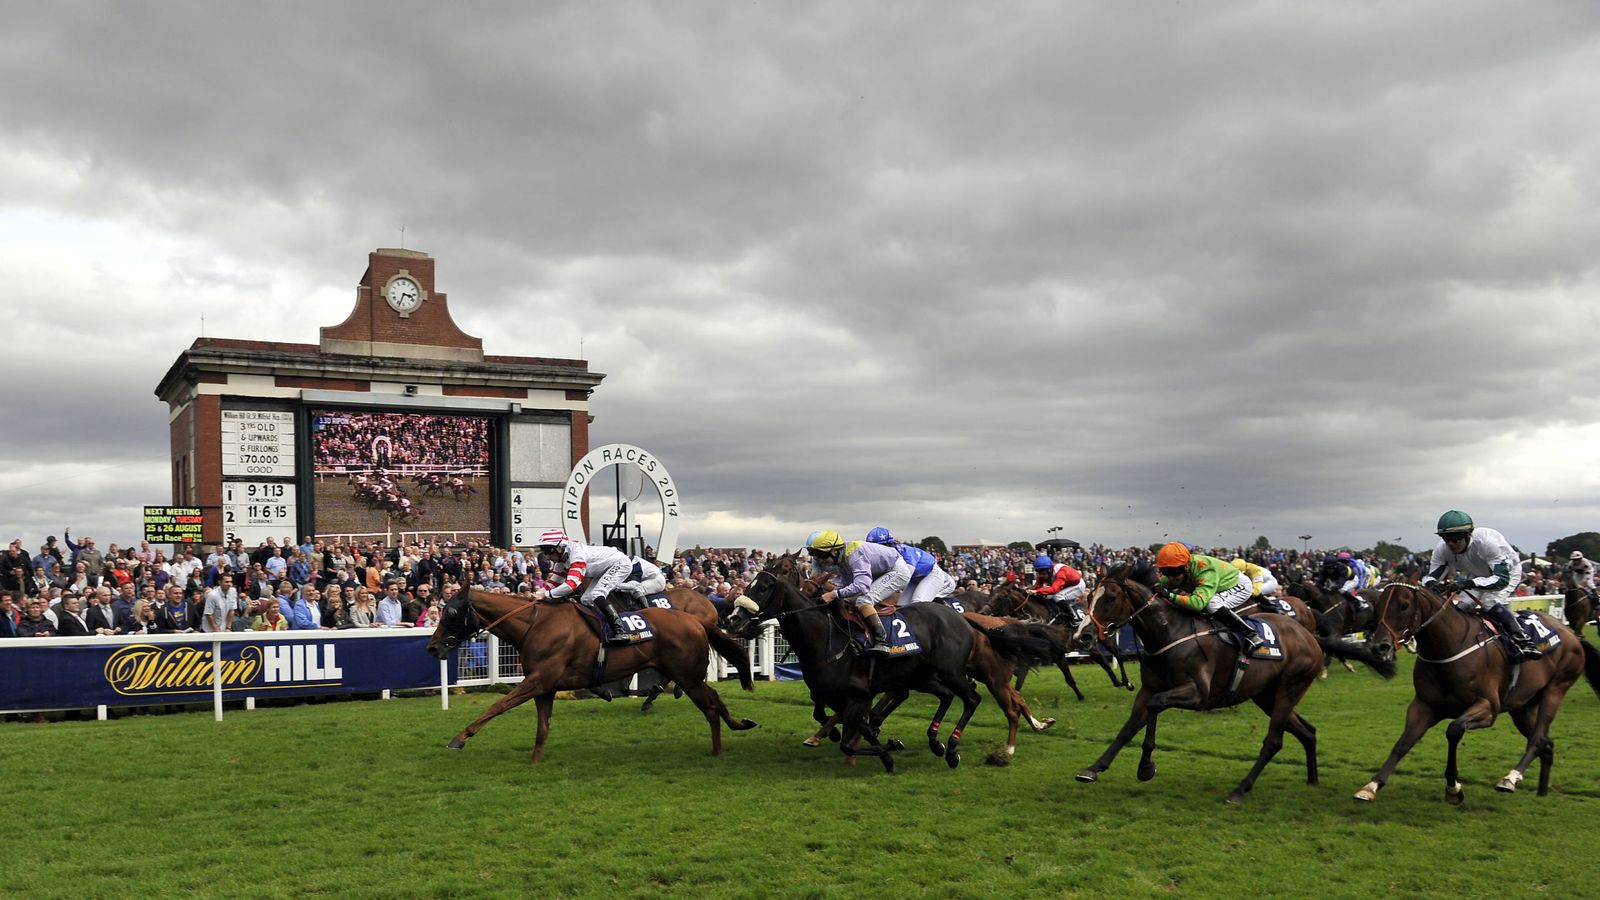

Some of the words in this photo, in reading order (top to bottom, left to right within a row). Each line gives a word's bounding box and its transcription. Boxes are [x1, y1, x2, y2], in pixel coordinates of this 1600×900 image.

[257, 423, 275, 431] OLD
[240, 444, 246, 452] 6
[566, 459, 594, 520] RIPON
[602, 447, 657, 472] RACES
[658, 477, 678, 517] 2014
[513, 495, 522, 505] 4
[145, 508, 165, 516] NEXT
[166, 508, 201, 516] MEETING
[225, 511, 236, 523] 2
[144, 516, 171, 524] MONDAY
[175, 516, 203, 524] TUESDAY
[513, 514, 522, 525] 5
[145, 524, 157, 533] 25
[162, 524, 175, 533] 26
[174, 524, 203, 533] AUGUST
[146, 534, 164, 542] First
[164, 534, 183, 542] Race
[225, 532, 235, 544] 3
[514, 533, 522, 544] 6
[652, 598, 671, 608] 18
[952, 602, 964, 613] 5
[1279, 600, 1291, 611] 8
[621, 615, 646, 631] 16
[892, 619, 910, 637] 2
[1262, 623, 1275, 644] 4
[104, 644, 263, 695] William
[263, 643, 343, 683] HILL
